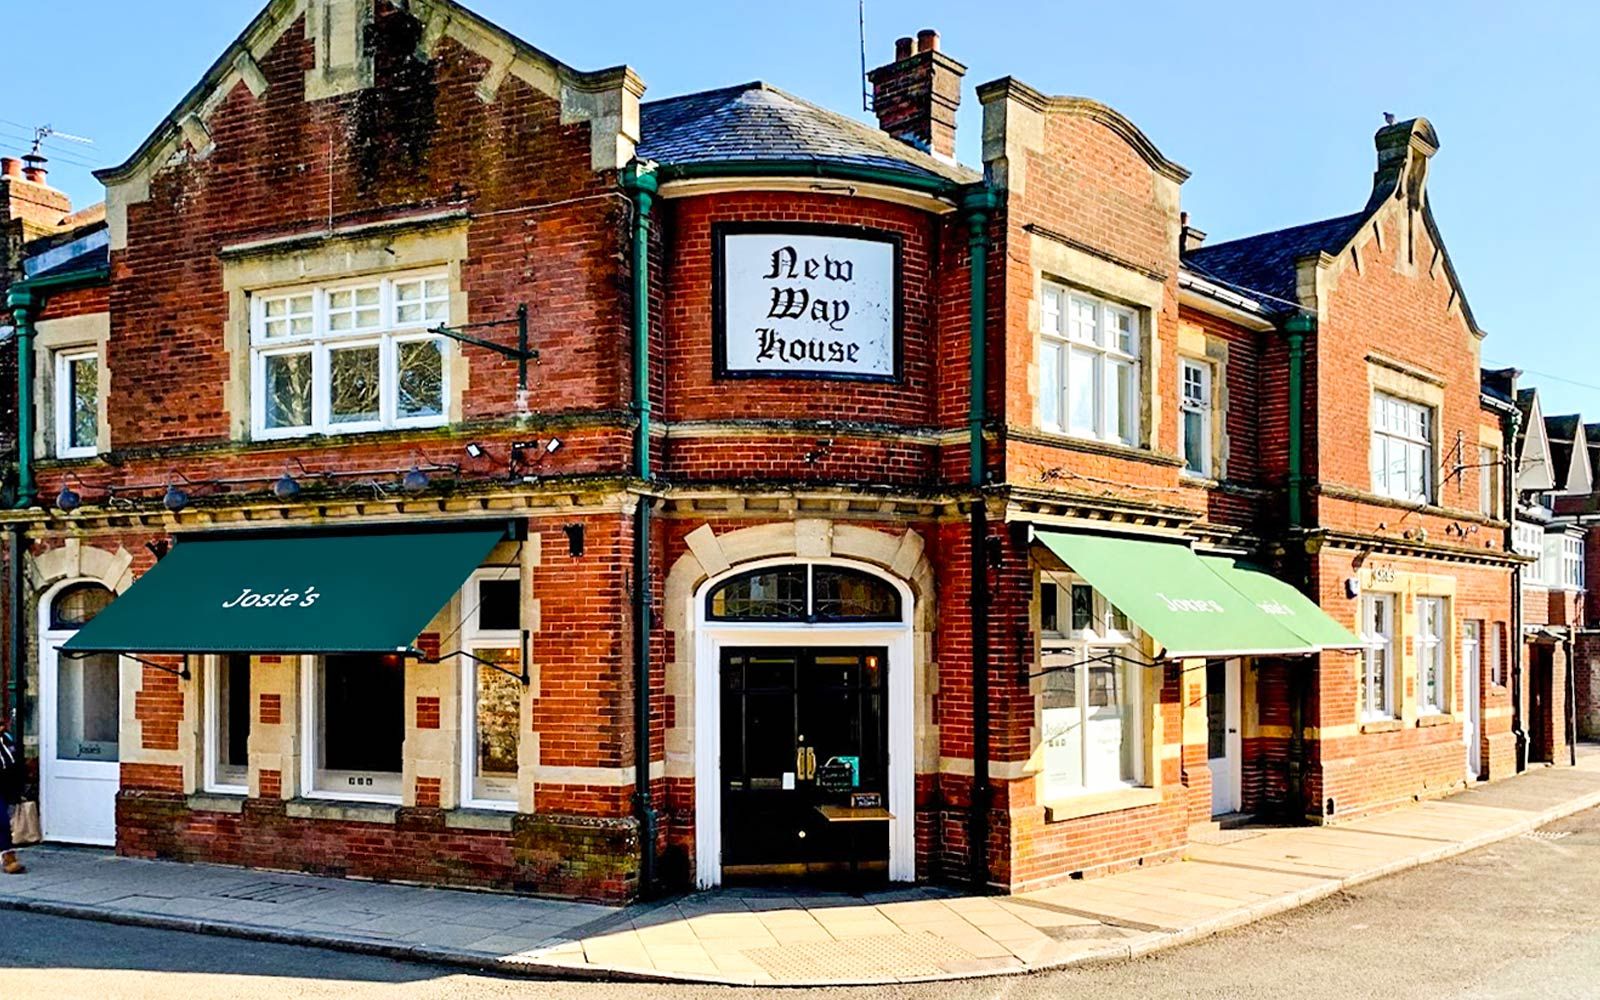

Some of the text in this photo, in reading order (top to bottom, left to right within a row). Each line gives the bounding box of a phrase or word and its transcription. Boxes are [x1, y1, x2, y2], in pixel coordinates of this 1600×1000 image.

[763, 246, 853, 282] New
[767, 287, 850, 331] Way
[755, 328, 860, 363] House
[222, 586, 321, 608] Josie's
